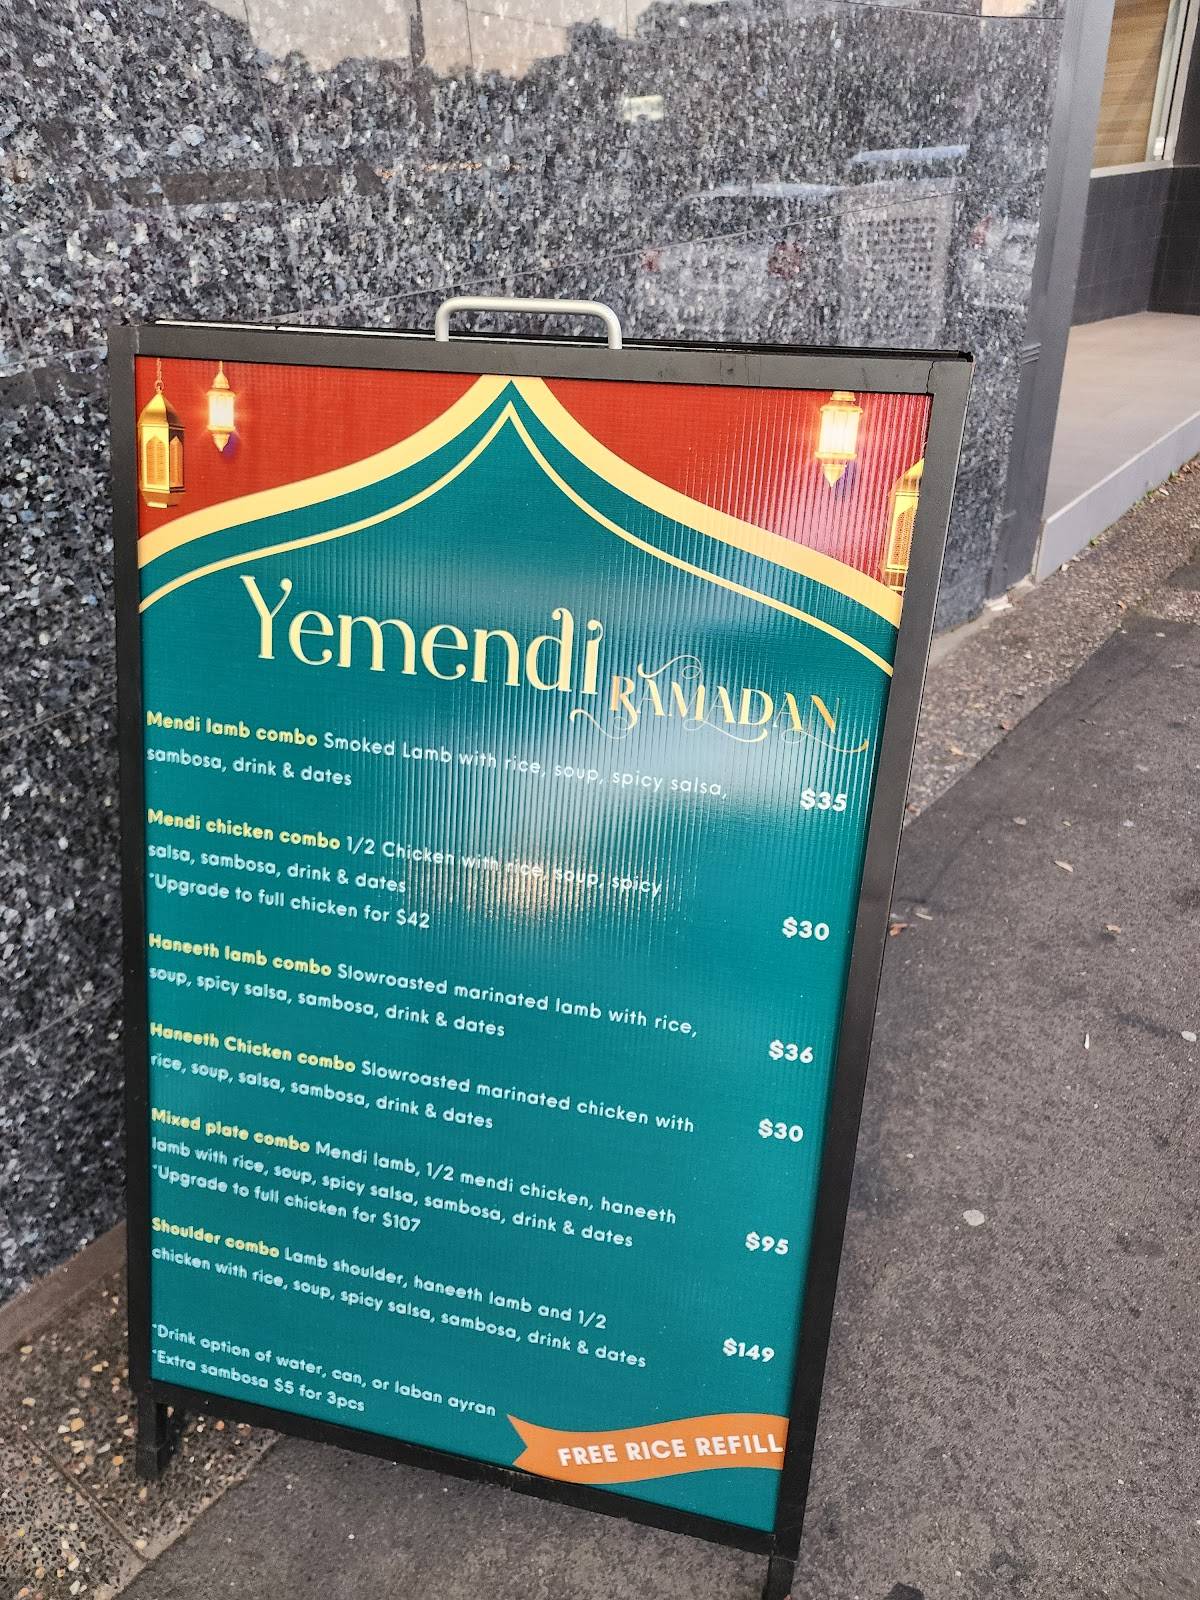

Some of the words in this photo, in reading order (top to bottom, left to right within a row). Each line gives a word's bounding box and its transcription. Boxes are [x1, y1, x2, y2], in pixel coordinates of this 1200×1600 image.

[239, 574, 603, 695] Yemendi
[570, 655, 869, 753] RAMADAN
[146, 710, 201, 733] Mendi
[206, 718, 251, 738] lamb
[256, 725, 318, 747] combo
[323, 732, 395, 756] Smoked
[403, 742, 451, 762] Lamb
[460, 753, 497, 768] with
[504, 758, 546, 777] rice,
[554, 764, 603, 784] soup,
[612, 771, 663, 791] spicy
[671, 777, 727, 799] salsa,
[146, 749, 227, 772] sambosa,
[233, 757, 277, 776] drink
[282, 762, 294, 779] &
[301, 765, 352, 786] dates
[800, 788, 847, 813] $35
[147, 809, 201, 830] Mendi
[206, 818, 273, 841] chicken
[279, 829, 341, 850] combo
[346, 836, 375, 855] 1/2
[382, 842, 454, 865] Chicken
[461, 854, 500, 872] with
[505, 860, 547, 881] rice,
[555, 869, 604, 888] soup,
[612, 874, 662, 897] spicy
[148, 844, 195, 865] salsa,
[200, 851, 281, 878] sambosa,
[287, 863, 331, 882] drink
[336, 869, 349, 885] &
[355, 873, 406, 893] dates
[235, 887, 252, 902] to
[258, 890, 285, 907] full
[290, 895, 358, 918] chicken
[363, 905, 389, 922] for
[396, 909, 430, 929] $42
[782, 916, 830, 941] $30
[148, 933, 219, 959] Haneeth
[225, 946, 268, 967] lamb
[272, 956, 332, 977] combo
[337, 963, 447, 994] Slowroasted
[454, 984, 548, 1011] marinated
[555, 997, 601, 1019] lamb
[608, 1008, 646, 1026] with
[654, 1015, 697, 1038] rice,
[149, 967, 193, 987] soup,
[196, 974, 240, 995] spicy
[244, 981, 292, 1004] salsa,
[297, 989, 379, 1017] sambosa,
[385, 1005, 429, 1024] drink
[435, 1012, 447, 1027] &
[453, 1017, 505, 1037] dates
[150, 1022, 219, 1048] Haneeth
[224, 1036, 292, 1061] Chicken
[297, 1051, 356, 1072] combo
[361, 1060, 470, 1093] Slowroasted
[476, 1082, 570, 1110] marinated
[576, 1099, 648, 1125] chicken
[655, 1113, 694, 1132] with
[769, 1040, 814, 1064] $36
[150, 1053, 186, 1074] rice,
[191, 1063, 233, 1083] soup,
[238, 1070, 285, 1093] salsa,
[290, 1078, 370, 1108] sambosa,
[376, 1095, 419, 1116] drink
[425, 1103, 437, 1118] &
[443, 1107, 493, 1129] dates
[758, 1118, 804, 1142] $30
[151, 1107, 201, 1130] Mixed
[205, 1119, 249, 1140] plate
[253, 1130, 310, 1153] combo
[315, 1141, 367, 1164] Mendi
[373, 1151, 421, 1176] lamb,
[426, 1162, 454, 1181] 1/2
[459, 1172, 514, 1193] mendi
[519, 1182, 594, 1210] chicken,
[601, 1196, 676, 1224] haneeth
[151, 1137, 191, 1157] lamb
[195, 1148, 228, 1165] with
[232, 1155, 269, 1175] rice,
[273, 1164, 316, 1185] soup,
[322, 1173, 366, 1196] spicy
[370, 1184, 418, 1206] salsa,
[424, 1192, 506, 1225] sambosa,
[512, 1210, 556, 1233] drink
[562, 1220, 575, 1235] &
[581, 1225, 633, 1247] dates
[232, 1182, 249, 1197] to
[254, 1185, 279, 1203] full
[284, 1194, 347, 1218] chicken
[352, 1206, 376, 1223] for
[382, 1212, 421, 1233] $107
[152, 1217, 221, 1246] Shoulder
[224, 1235, 280, 1258] combo
[284, 1247, 328, 1269] Lamb
[332, 1258, 407, 1288] shoulder,
[413, 1274, 483, 1303] haneeth
[489, 1290, 532, 1313] lamb
[538, 1303, 572, 1322] and
[578, 1310, 607, 1329] 1/2
[745, 1231, 789, 1255] $95
[152, 1247, 210, 1271] chicken
[215, 1260, 247, 1280] with
[252, 1269, 288, 1291] rice,
[292, 1280, 335, 1301] soup,
[340, 1289, 382, 1311] spicy
[387, 1300, 435, 1323] salsa,
[440, 1312, 521, 1343] sambosa,
[527, 1329, 571, 1351] drink
[576, 1340, 589, 1355] &
[595, 1345, 646, 1368] dates
[200, 1336, 250, 1359] option
[255, 1349, 272, 1363] of
[276, 1355, 327, 1378] water,
[332, 1368, 367, 1387] can,
[372, 1378, 390, 1393] or
[394, 1381, 443, 1404] laban
[448, 1396, 496, 1417] ayran
[723, 1338, 775, 1362] $149
[200, 1363, 269, 1388] sambosa
[273, 1378, 294, 1395] $5
[299, 1384, 323, 1401] for
[327, 1391, 365, 1412] 3pcs
[558, 1443, 618, 1467] FREE
[625, 1438, 687, 1461] RICE
[694, 1434, 784, 1456] REFILL
